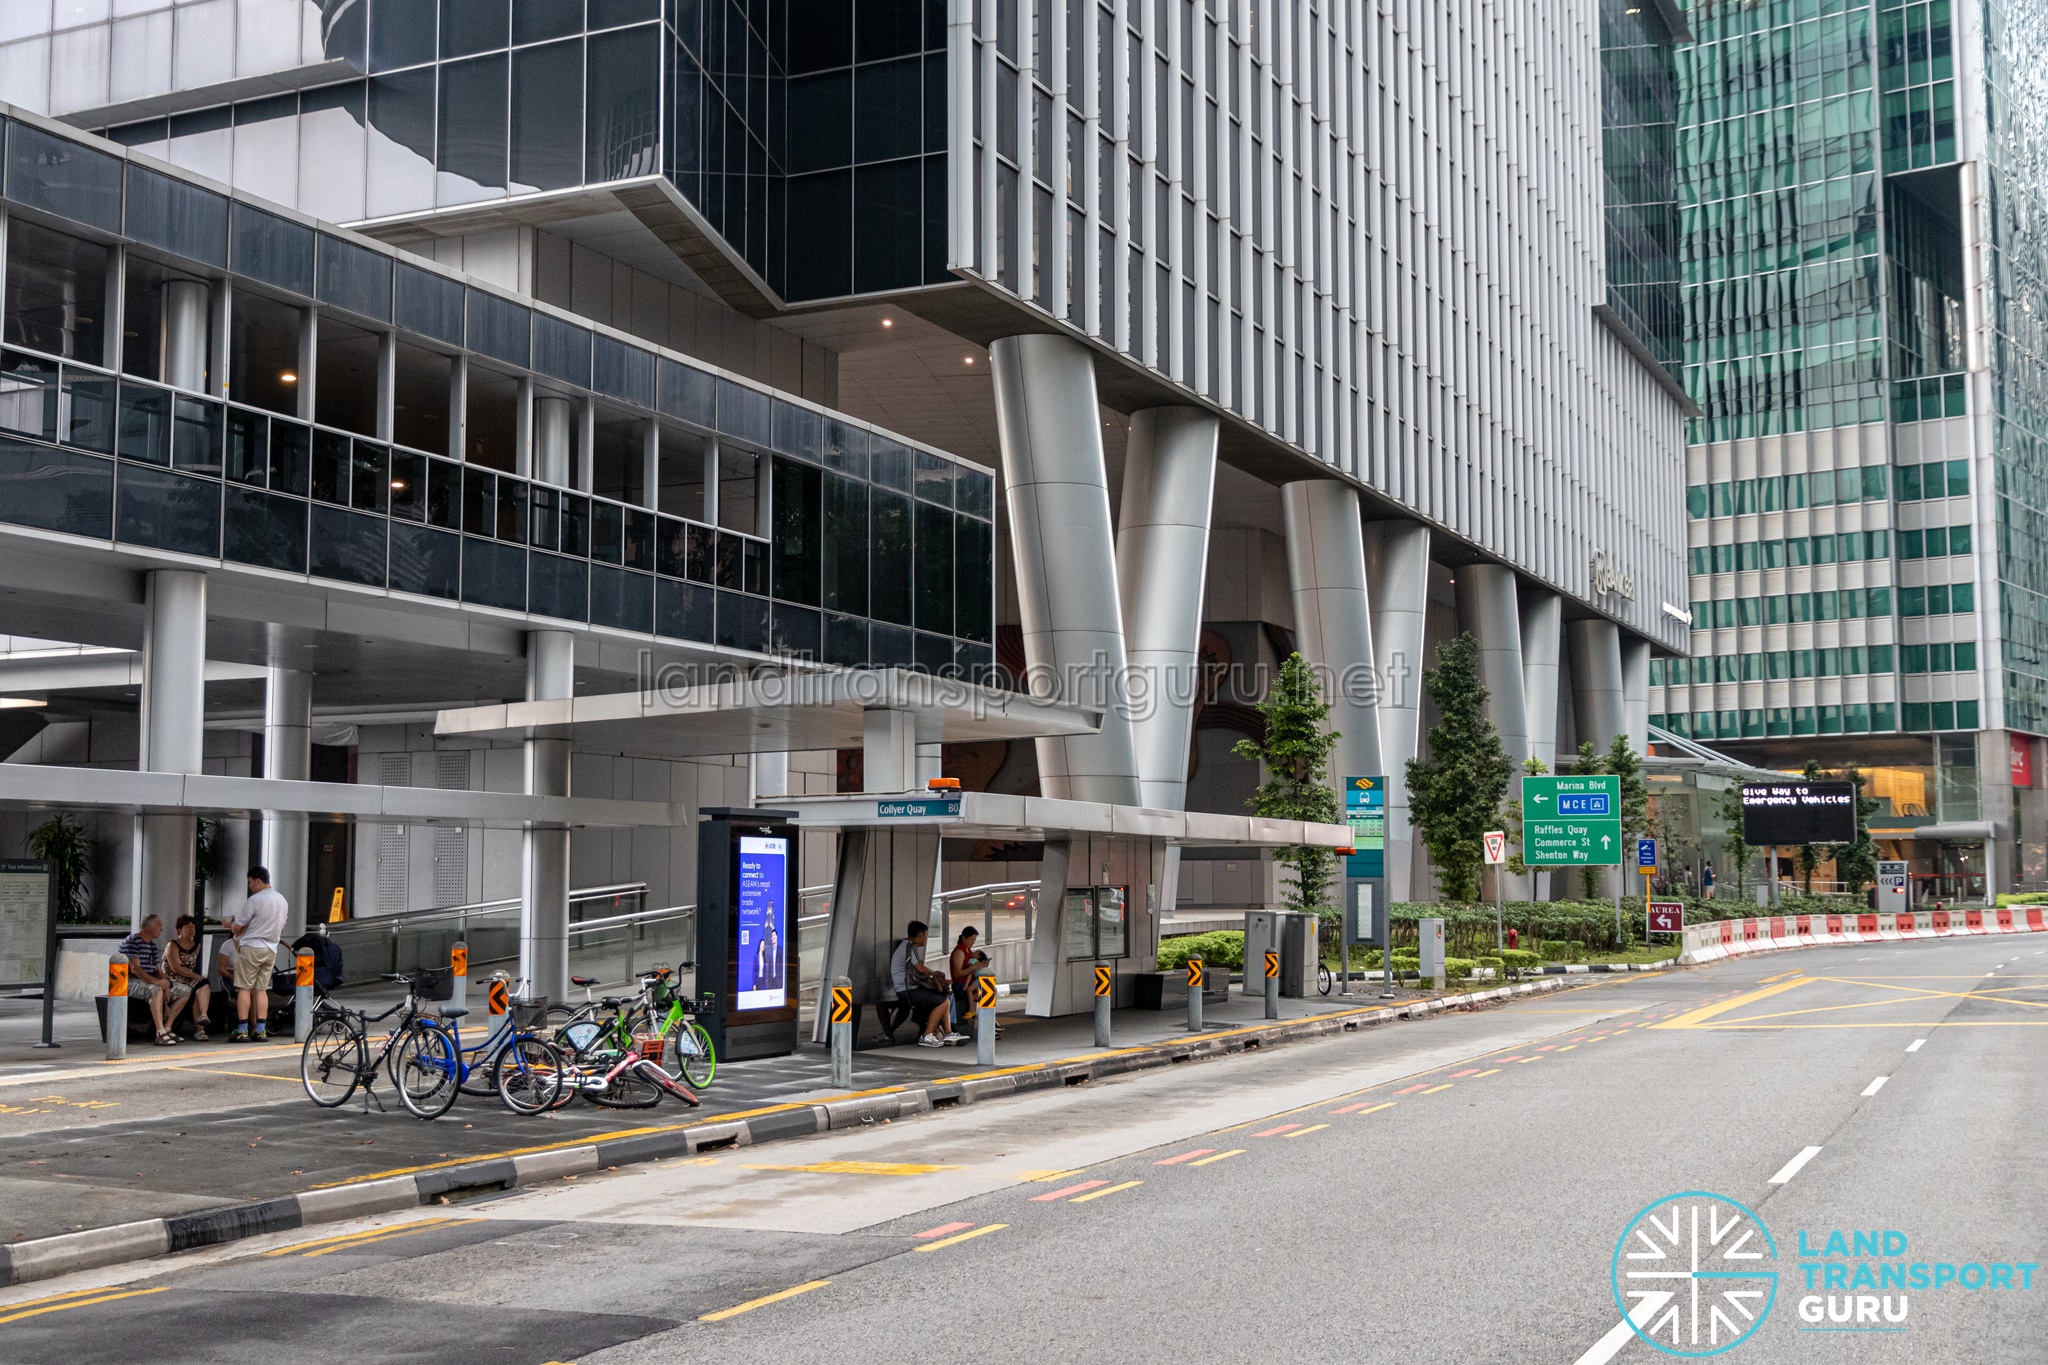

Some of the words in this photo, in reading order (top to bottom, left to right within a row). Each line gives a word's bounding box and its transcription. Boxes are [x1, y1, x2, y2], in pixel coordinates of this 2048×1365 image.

[1556, 781, 1585, 790] Marina
[1589, 780, 1606, 790] Blvd
[1772, 787, 1791, 796] Way
[1795, 787, 1809, 795] to
[1742, 797, 1797, 805] Emergency
[1801, 795, 1851, 804] Vehicles
[879, 804, 905, 816] Collyer
[906, 804, 927, 815] Quay
[1534, 825, 1563, 834] Raffles
[1567, 825, 1588, 836] Quay
[1534, 838, 1577, 847] Commerce
[1581, 837, 1591, 846] St
[1535, 850, 1568, 860] Shenton
[1572, 850, 1589, 861] Way
[742, 862, 756, 870] Ready
[757, 862, 761, 870] to
[1650, 906, 1680, 914] AUREA
